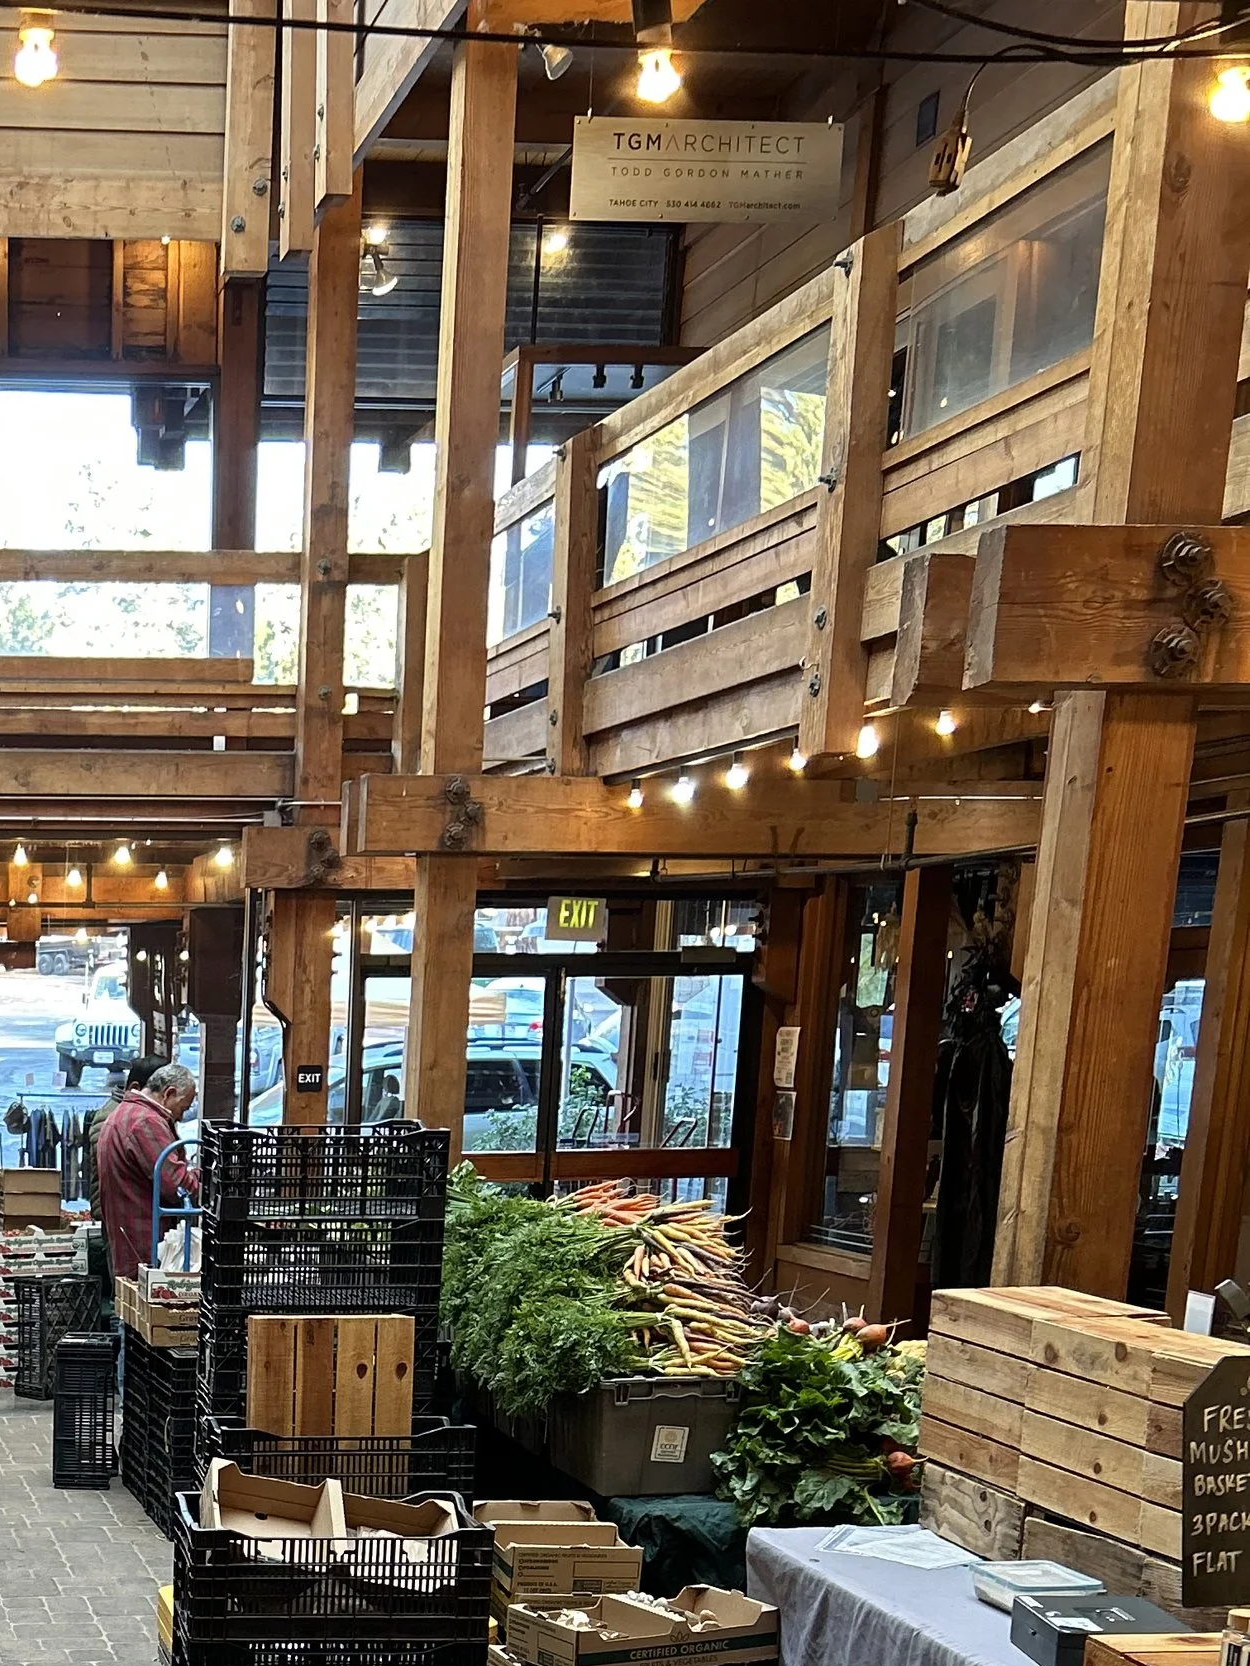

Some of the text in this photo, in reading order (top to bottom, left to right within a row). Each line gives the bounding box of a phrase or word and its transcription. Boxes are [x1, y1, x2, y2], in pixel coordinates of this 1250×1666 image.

[611, 166, 804, 180] TODD GORDON MATHER
[609, 198, 637, 208] TAHOE
[639, 199, 659, 208] CITY
[558, 897, 600, 929] EXIT
[298, 1073, 322, 1084] EXIT
[1192, 1549, 1243, 1577] FLAT
[629, 1640, 730, 1661] CERTIFIED ORGANIC
[673, 1655, 719, 1666] VEGETABLES
